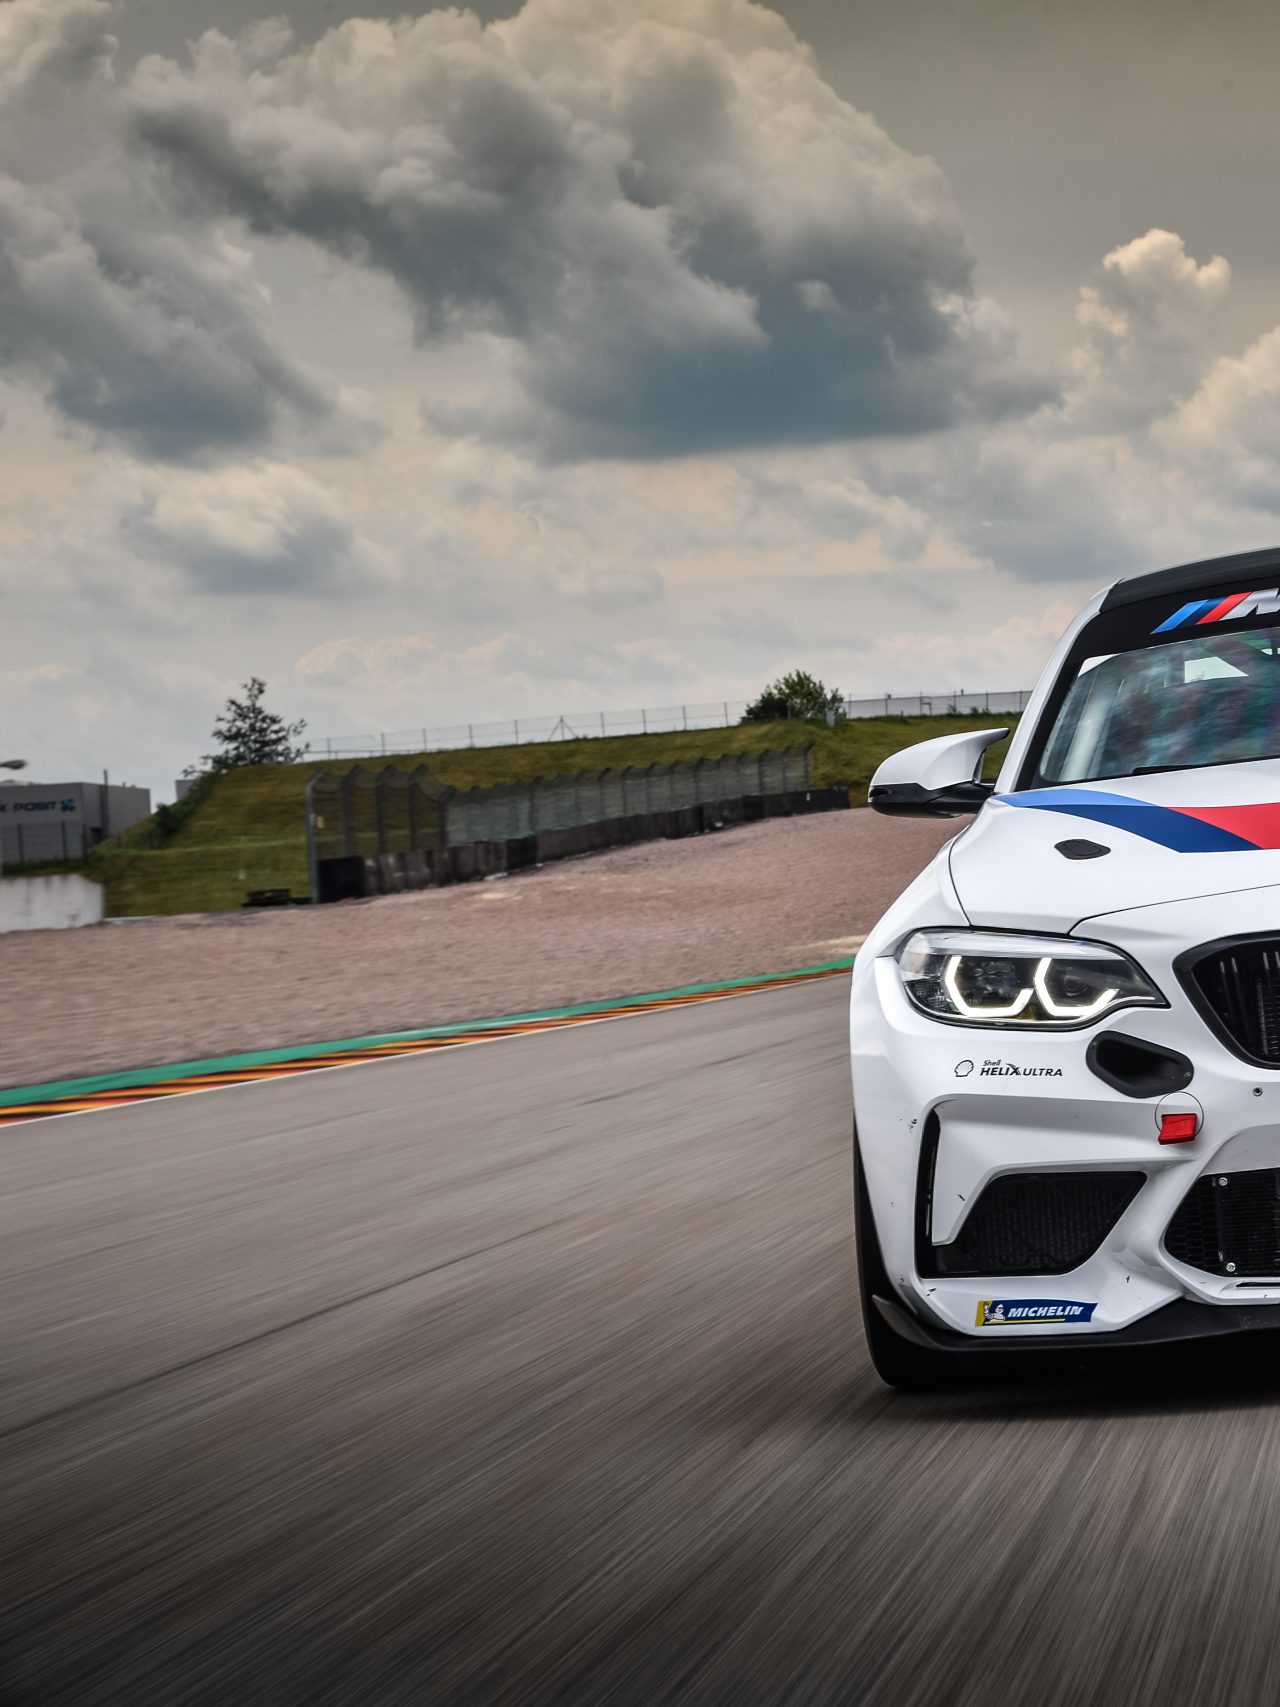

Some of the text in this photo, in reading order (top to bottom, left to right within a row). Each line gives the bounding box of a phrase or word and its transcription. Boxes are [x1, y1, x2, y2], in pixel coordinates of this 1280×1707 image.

[983, 1059, 1002, 1067] Shell
[980, 1063, 1063, 1077] HELIX ULTRA
[1007, 1305, 1084, 1318] MICHELIN
